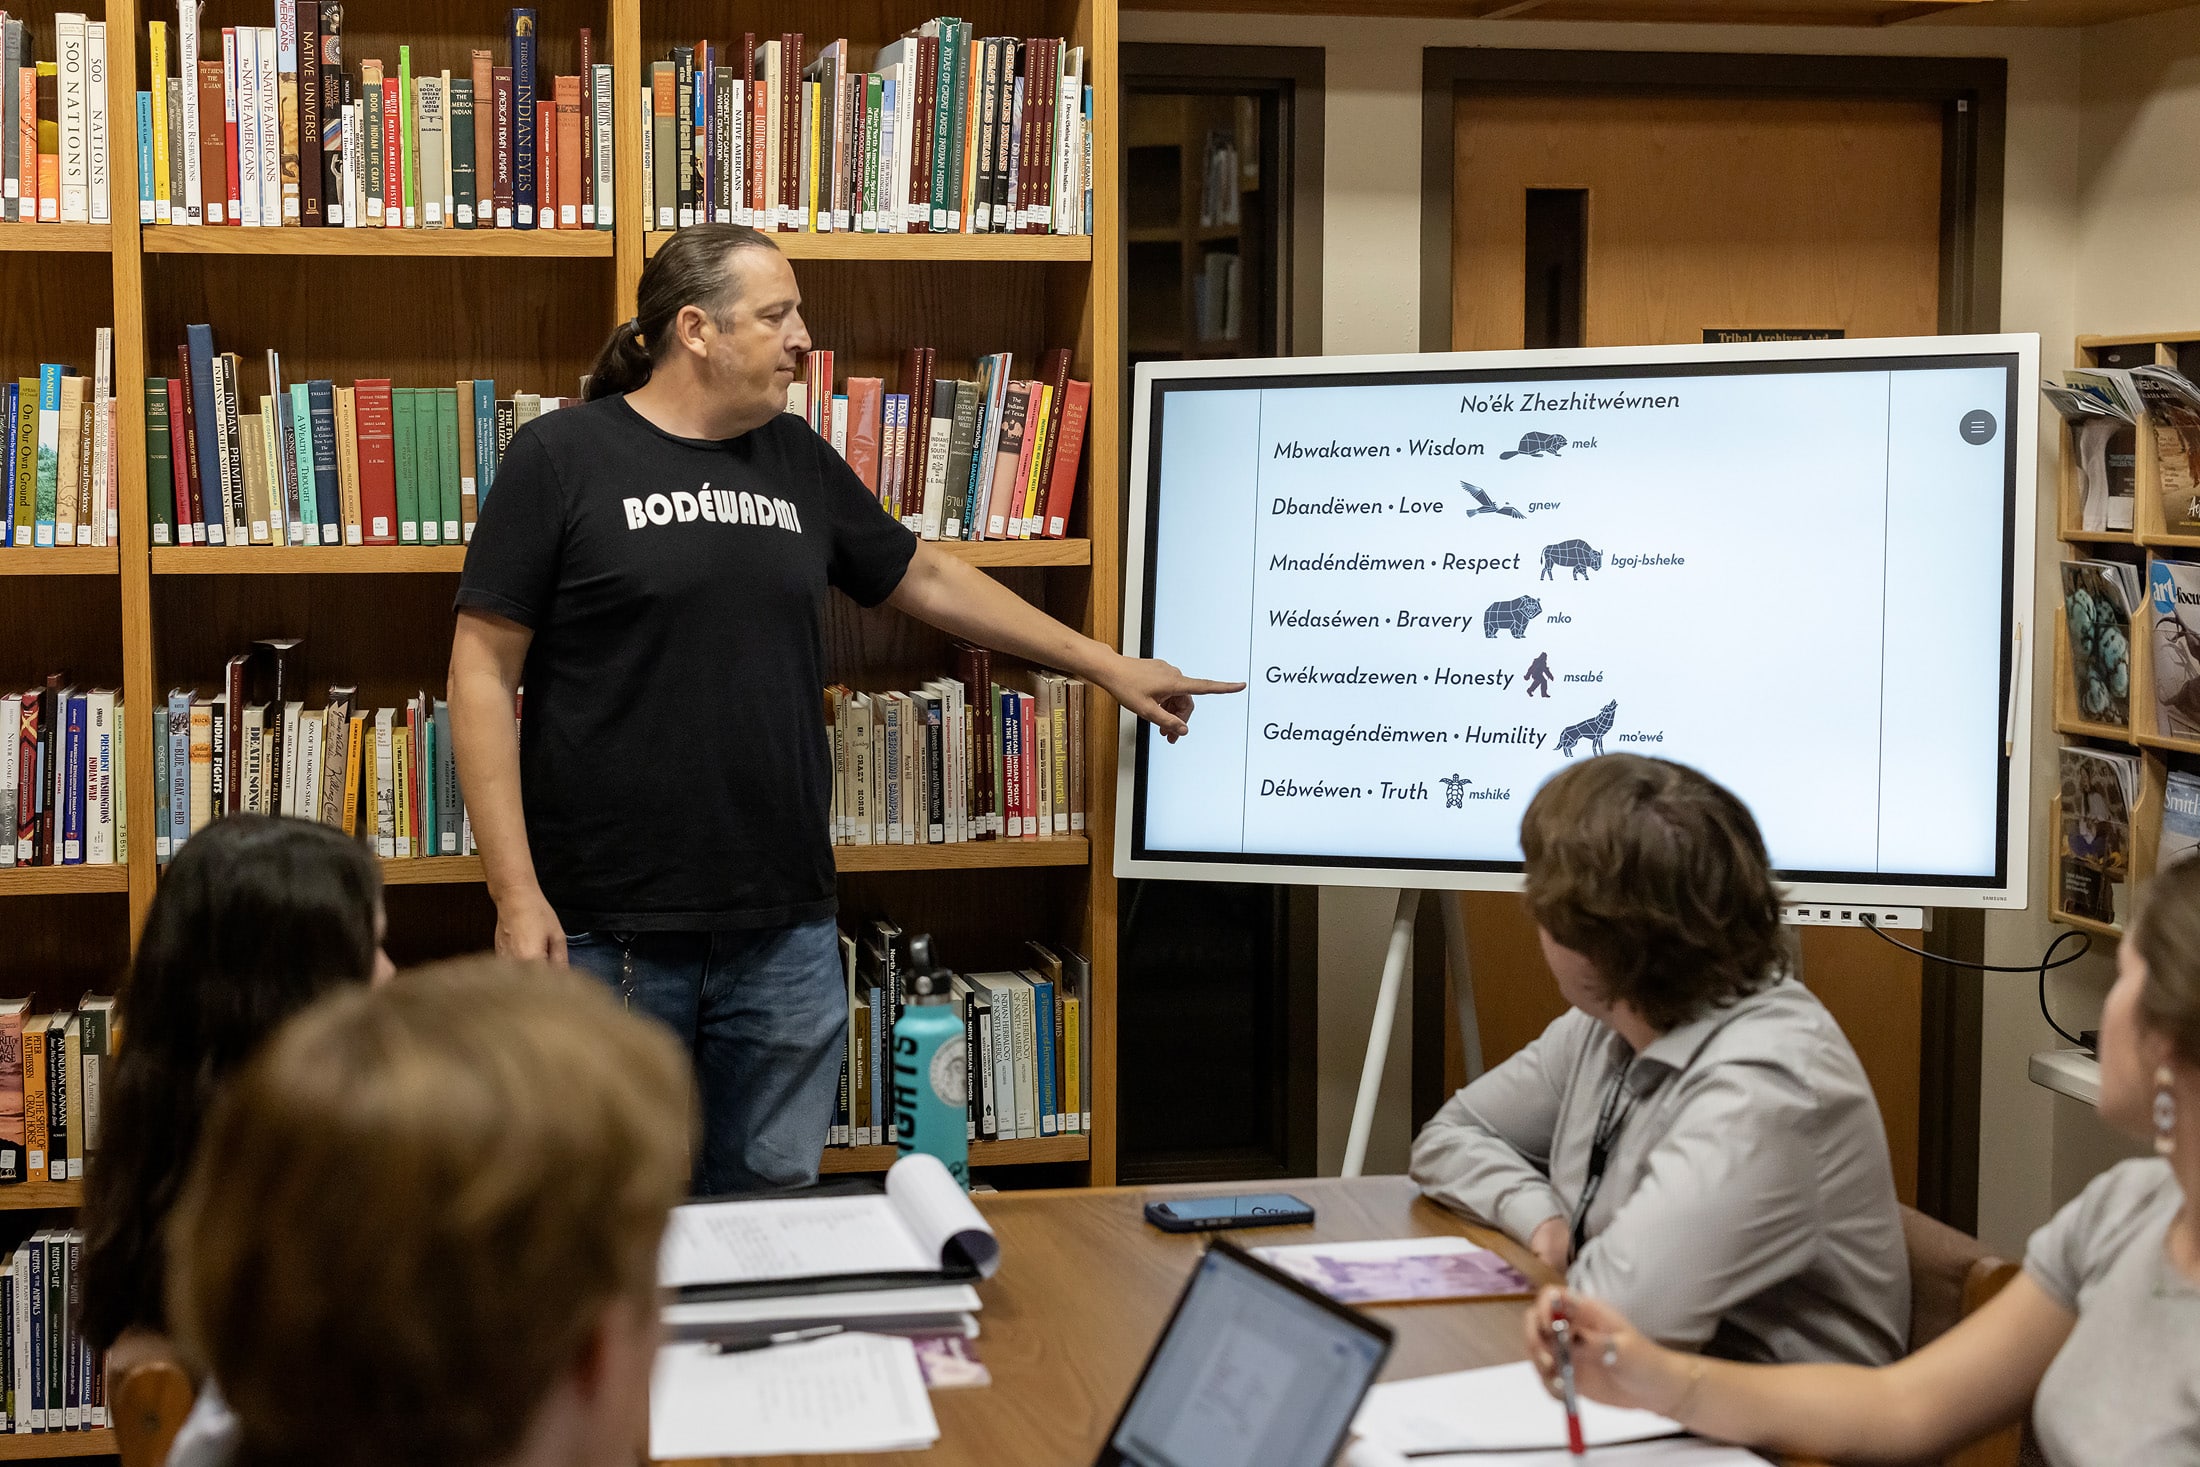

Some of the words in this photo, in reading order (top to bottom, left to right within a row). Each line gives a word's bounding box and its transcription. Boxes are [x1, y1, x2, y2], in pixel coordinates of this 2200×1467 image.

[66, 41, 80, 73] 500
[304, 31, 315, 77] NATIVE
[520, 42, 529, 82] THROUGH
[942, 46, 953, 72] ATLAS
[91, 59, 102, 83] 500
[24, 72, 33, 101] Indians
[243, 70, 254, 111] NATIVE
[263, 71, 274, 112] NATIVE
[324, 75, 332, 108] UNIVERSE
[305, 82, 316, 143] UNIVERSE
[370, 93, 378, 112] BOOK
[518, 85, 532, 146] INDIAN
[67, 82, 81, 176] NATIONS
[680, 85, 693, 148] American
[24, 127, 34, 168] Woodlands
[93, 110, 104, 185] NATIONS
[244, 112, 255, 182] AMERICANS
[264, 114, 276, 183] AMERICANS
[371, 125, 379, 149] INDIAN
[371, 152, 379, 165] LIFE
[680, 150, 693, 191] Indian
[371, 167, 380, 192] CRAFTS
[519, 153, 532, 192] EYES
[935, 169, 945, 204] HISTORY
[1718, 333, 1751, 343] Tribal
[1807, 333, 1829, 341] And
[45, 367, 55, 409] MANITOU
[22, 404, 34, 420] On
[225, 392, 237, 435] INDIAN
[885, 399, 895, 424] TEXAS
[897, 399, 907, 424] TEXAS
[1007, 402, 1025, 411] Indians
[1519, 391, 1680, 413] Zhezhitwéwnen
[22, 423, 33, 442] Our
[498, 409, 506, 450] CIVILIZED
[884, 425, 894, 457] INDIAN
[896, 425, 906, 457] INDIAN
[20, 446, 32, 469] Own
[1274, 440, 1390, 459] Mbwakawen
[1409, 437, 1485, 456] Wisdom
[1571, 436, 1598, 450] mek
[19, 472, 31, 507] Ground
[230, 447, 243, 509] PRIMITIVE
[622, 482, 802, 533] BODÉWADMI
[1271, 497, 1383, 515] Dbandëwen
[1400, 497, 1444, 514] Love
[1528, 500, 1561, 515] gnew
[1269, 552, 1425, 571] Mnadéndëmwen
[1443, 553, 1521, 575] Respect
[1611, 553, 1685, 569] bgoj-bsheke
[2152, 578, 2177, 603] art
[1269, 609, 1380, 628] Wédaséwen
[1397, 610, 1473, 633] Bravery
[1547, 611, 1572, 625] mko
[1265, 665, 1417, 685] Gwékwadzewen
[1434, 667, 1515, 691] Honesty
[1564, 670, 1604, 683] msabé
[214, 716, 223, 752] INDIAN
[1005, 718, 1012, 726] IN
[1054, 708, 1065, 738] Indians
[307, 735, 313, 743] OF
[931, 725, 939, 750] Between
[1055, 740, 1066, 754] and
[1263, 722, 1448, 747] Gdemagéndëmwen
[1466, 726, 1548, 750] Humility
[100, 734, 109, 772] PRESIDENT
[157, 745, 165, 782] OSCEOLA
[249, 726, 260, 774] DEATH
[88, 757, 98, 782] INDIAN
[213, 757, 223, 794] FIGHTS
[1055, 756, 1067, 804] Bureaucrats
[88, 784, 98, 801] WAR
[100, 774, 111, 824] WASHINGTON'S
[248, 776, 260, 811] SONG
[932, 782, 940, 799] White
[1261, 779, 1362, 799] Débwéwen
[1380, 781, 1428, 800] Truth
[1468, 788, 1511, 802] mshiké
[932, 800, 940, 819] Worlds
[992, 993, 1000, 1004] OF
[1001, 993, 1009, 1019] INDIAN
[1013, 992, 1020, 1002] OF
[1021, 991, 1029, 1017] INDIAN
[1013, 1003, 1021, 1029] NORTH
[58, 1037, 66, 1051] AN
[994, 1032, 1002, 1064] AMERICA
[1002, 1020, 1011, 1061] HERBALOGY
[1014, 1030, 1022, 1062] AMERICA
[1022, 1019, 1030, 1059] HERBALOGY
[25, 1036, 34, 1079] MATTHIESSEN
[58, 1053, 66, 1085] INDIAN
[25, 1095, 35, 1117] CRAZY
[36, 1090, 44, 1099] IN
[36, 1100, 44, 1114] THE
[58, 1086, 66, 1126] CANAAN
[27, 1119, 36, 1144] HORSE
[37, 1115, 45, 1139] SPIRIT
[37, 1140, 46, 1150] OF
[32, 1249, 40, 1274] KEEPERS
[52, 1246, 60, 1271] KEEPERS
[52, 1276, 60, 1288] LIFE
[32, 1287, 41, 1316] ANIMALS
